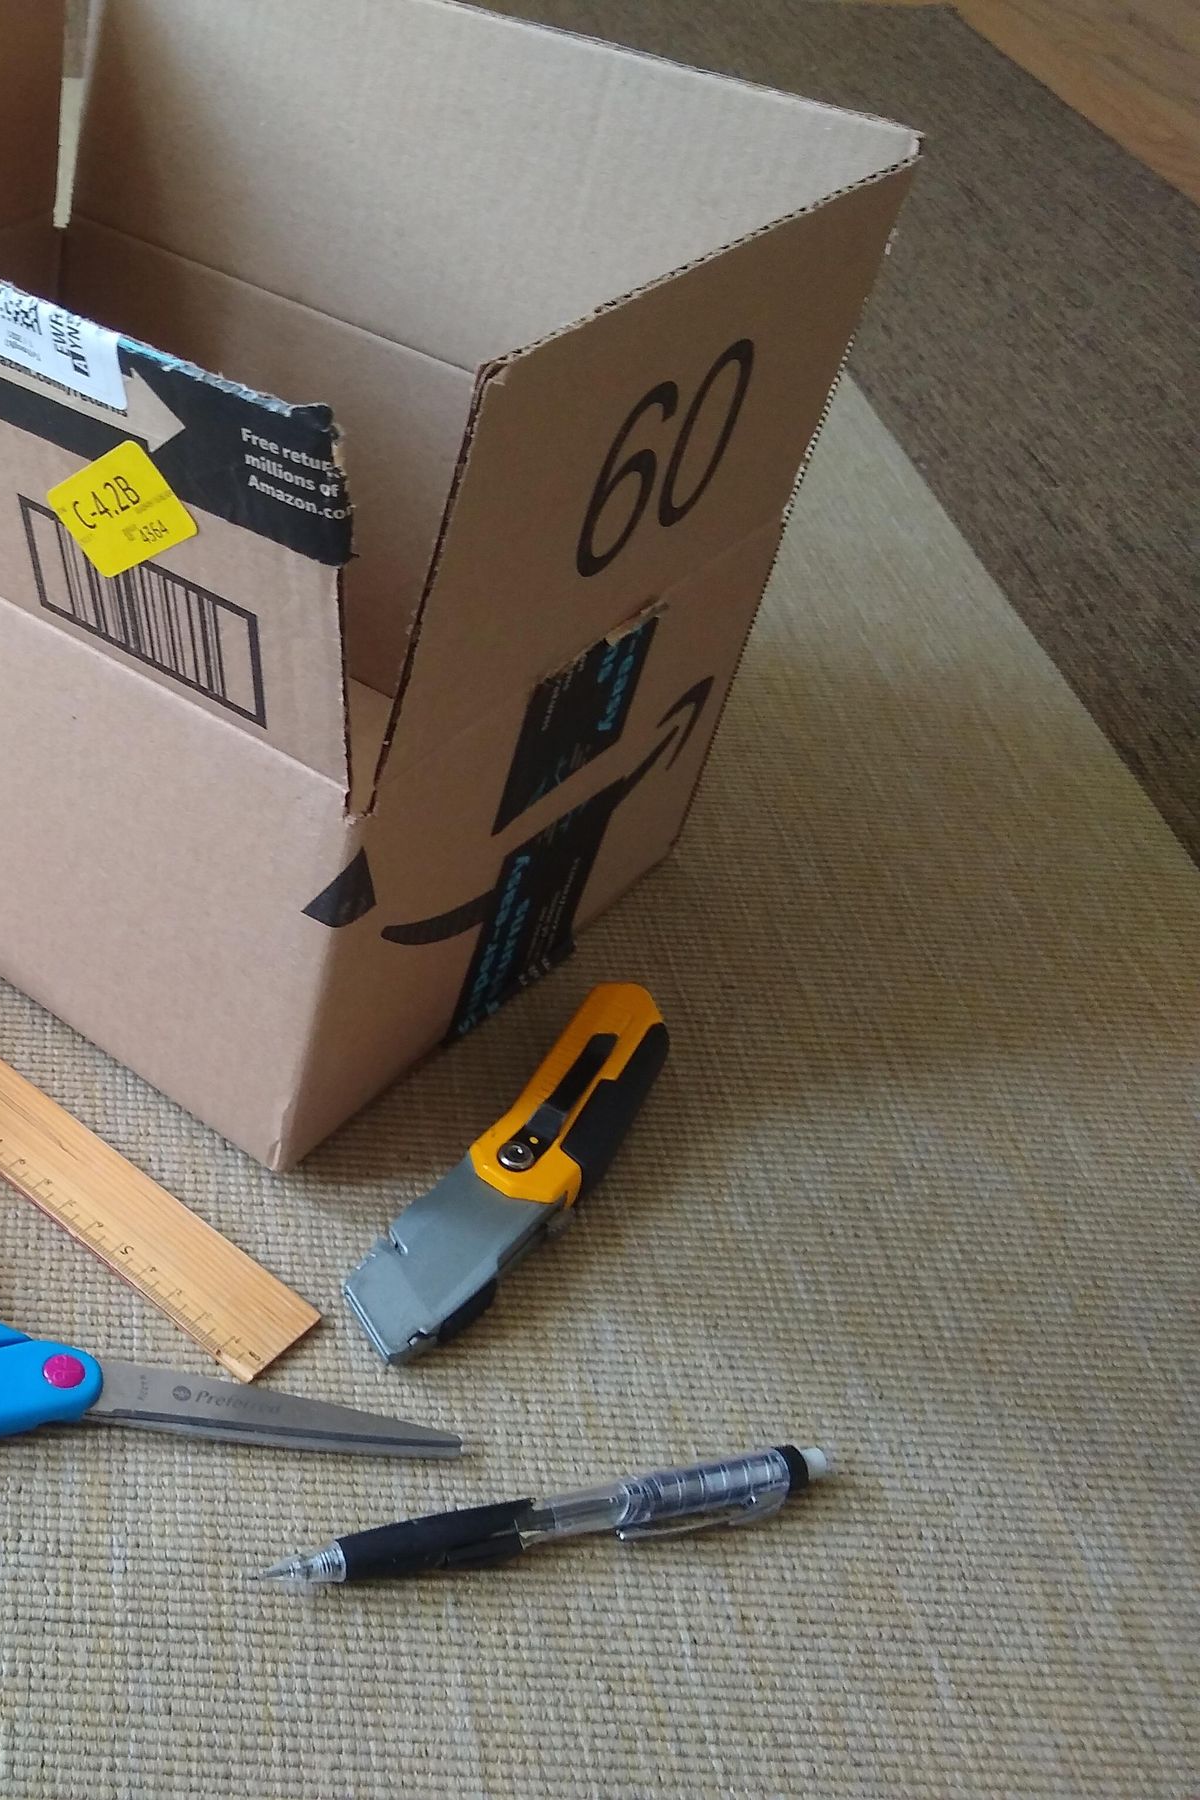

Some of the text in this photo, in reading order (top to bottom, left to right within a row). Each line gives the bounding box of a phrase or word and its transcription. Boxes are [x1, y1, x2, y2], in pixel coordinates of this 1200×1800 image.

[241, 427, 280, 454] Free
[576, 338, 754, 577] 60
[244, 454, 340, 497] millions of
[73, 475, 141, 529] C-4.2B
[120, 1244, 133, 1255] 5
